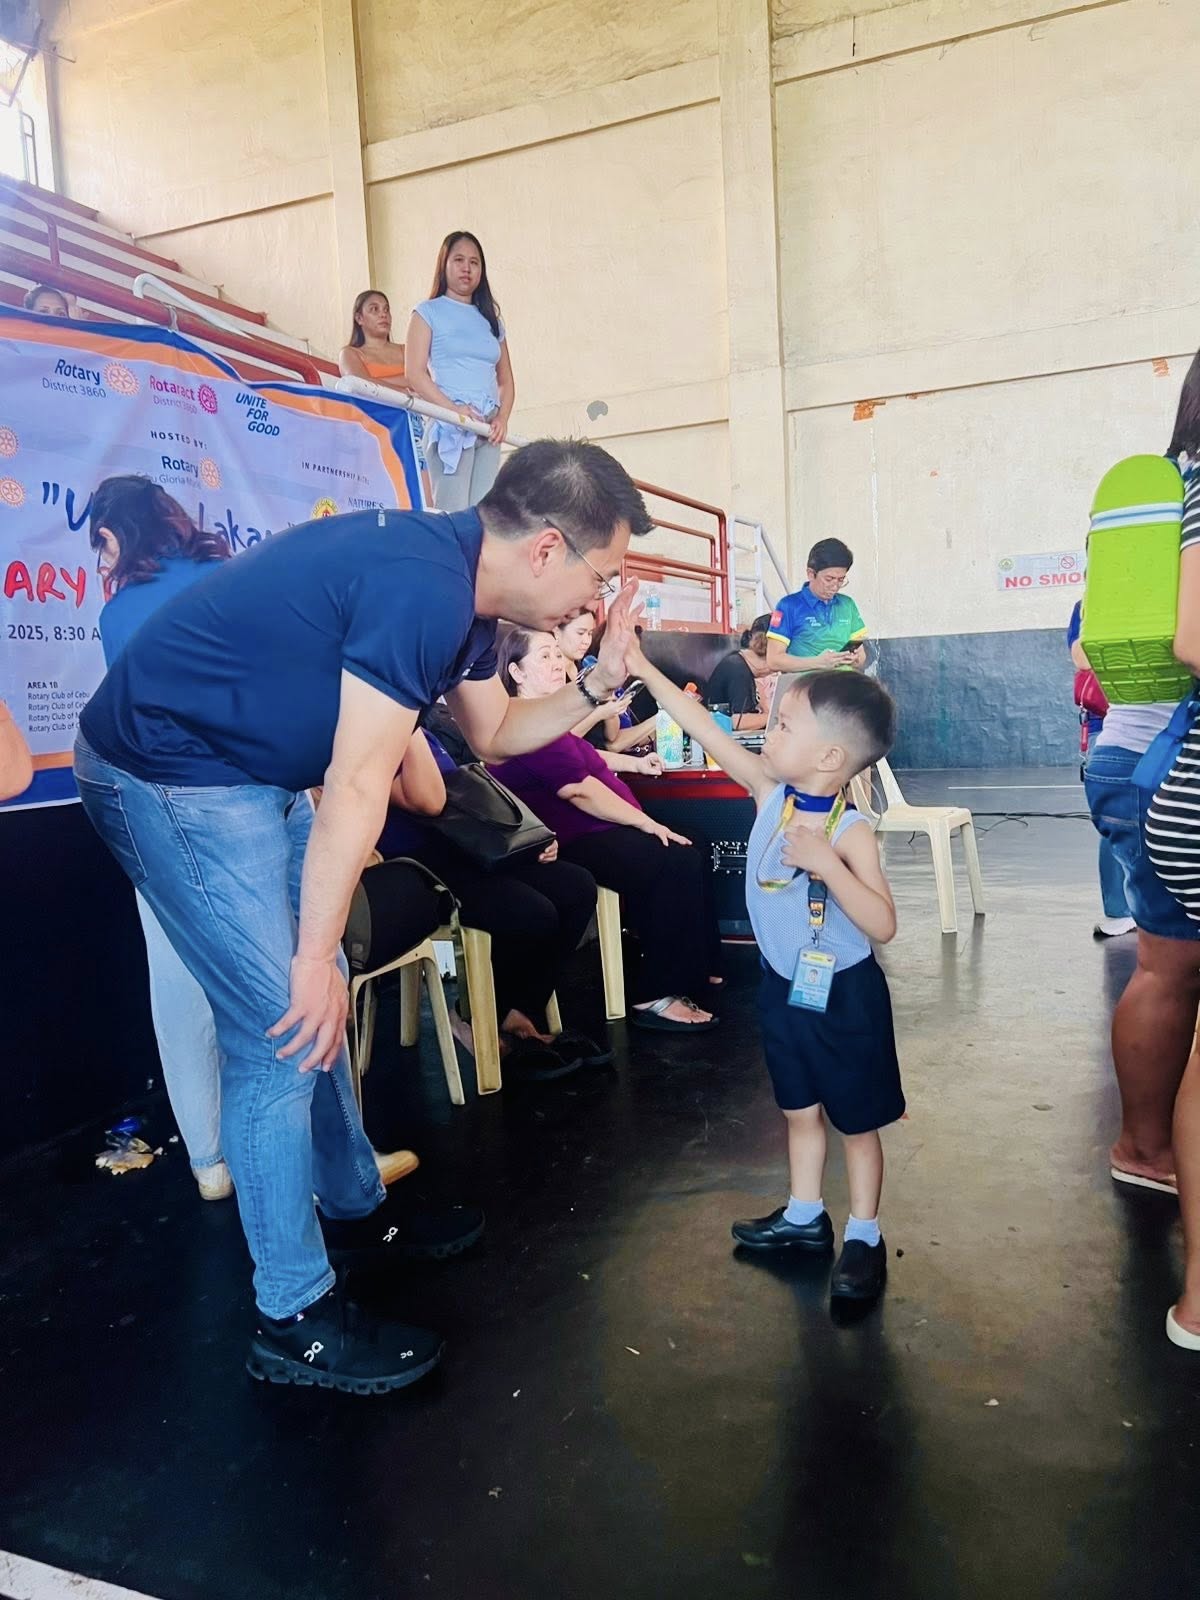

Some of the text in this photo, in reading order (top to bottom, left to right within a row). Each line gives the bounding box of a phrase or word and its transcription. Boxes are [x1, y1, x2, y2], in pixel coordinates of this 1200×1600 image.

[54, 358, 100, 385] Rotary
[42, 377, 107, 398] District 3860
[149, 375, 196, 401] Rotaract
[235, 392, 268, 409] UNITE
[246, 407, 269, 422] FOR
[247, 420, 280, 437] GOOD
[150, 430, 190, 444] HOSTED
[161, 456, 199, 478] Rotary
[301, 461, 310, 470] IN
[312, 463, 356, 480] PARTNERSHIP
[159, 475, 188, 485] Gloria
[4, 560, 87, 608] ARY
[1005, 572, 1087, 588] NO SMO
[8, 624, 102, 642] 2025, 8:30 A
[27, 681, 47, 689] AREA
[27, 693, 50, 701] Rotary
[51, 691, 66, 699] Club
[66, 691, 74, 699] of
[28, 703, 50, 712] Rotary
[51, 702, 66, 710] Club
[66, 701, 74, 710] of
[28, 714, 51, 723] Rotary
[51, 713, 66, 721] Club
[29, 725, 51, 734] Rotary
[52, 723, 67, 731] Club
